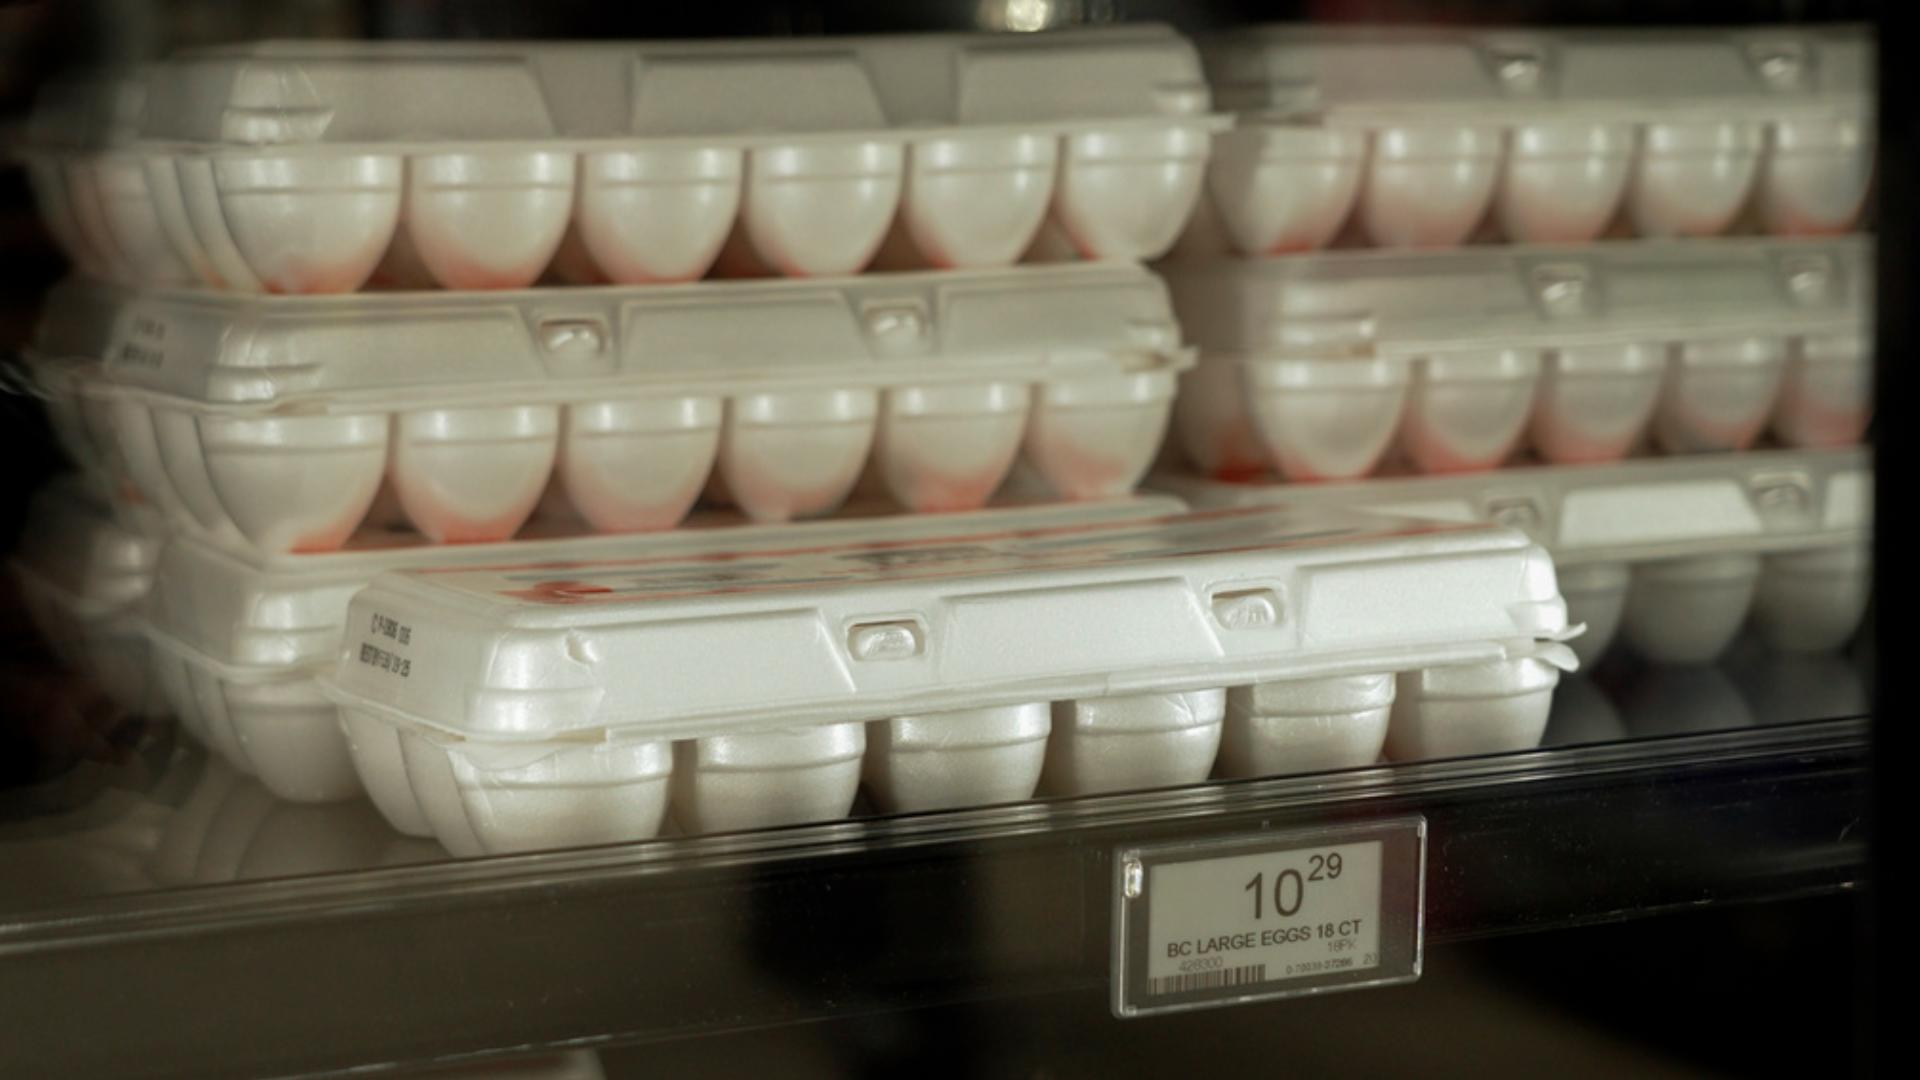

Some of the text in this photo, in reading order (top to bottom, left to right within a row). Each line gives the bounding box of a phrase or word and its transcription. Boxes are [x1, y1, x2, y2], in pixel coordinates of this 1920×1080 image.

[1244, 853, 1342, 919] 10 29
[1167, 919, 1362, 957] BC LARGE EGGS 18 CT
